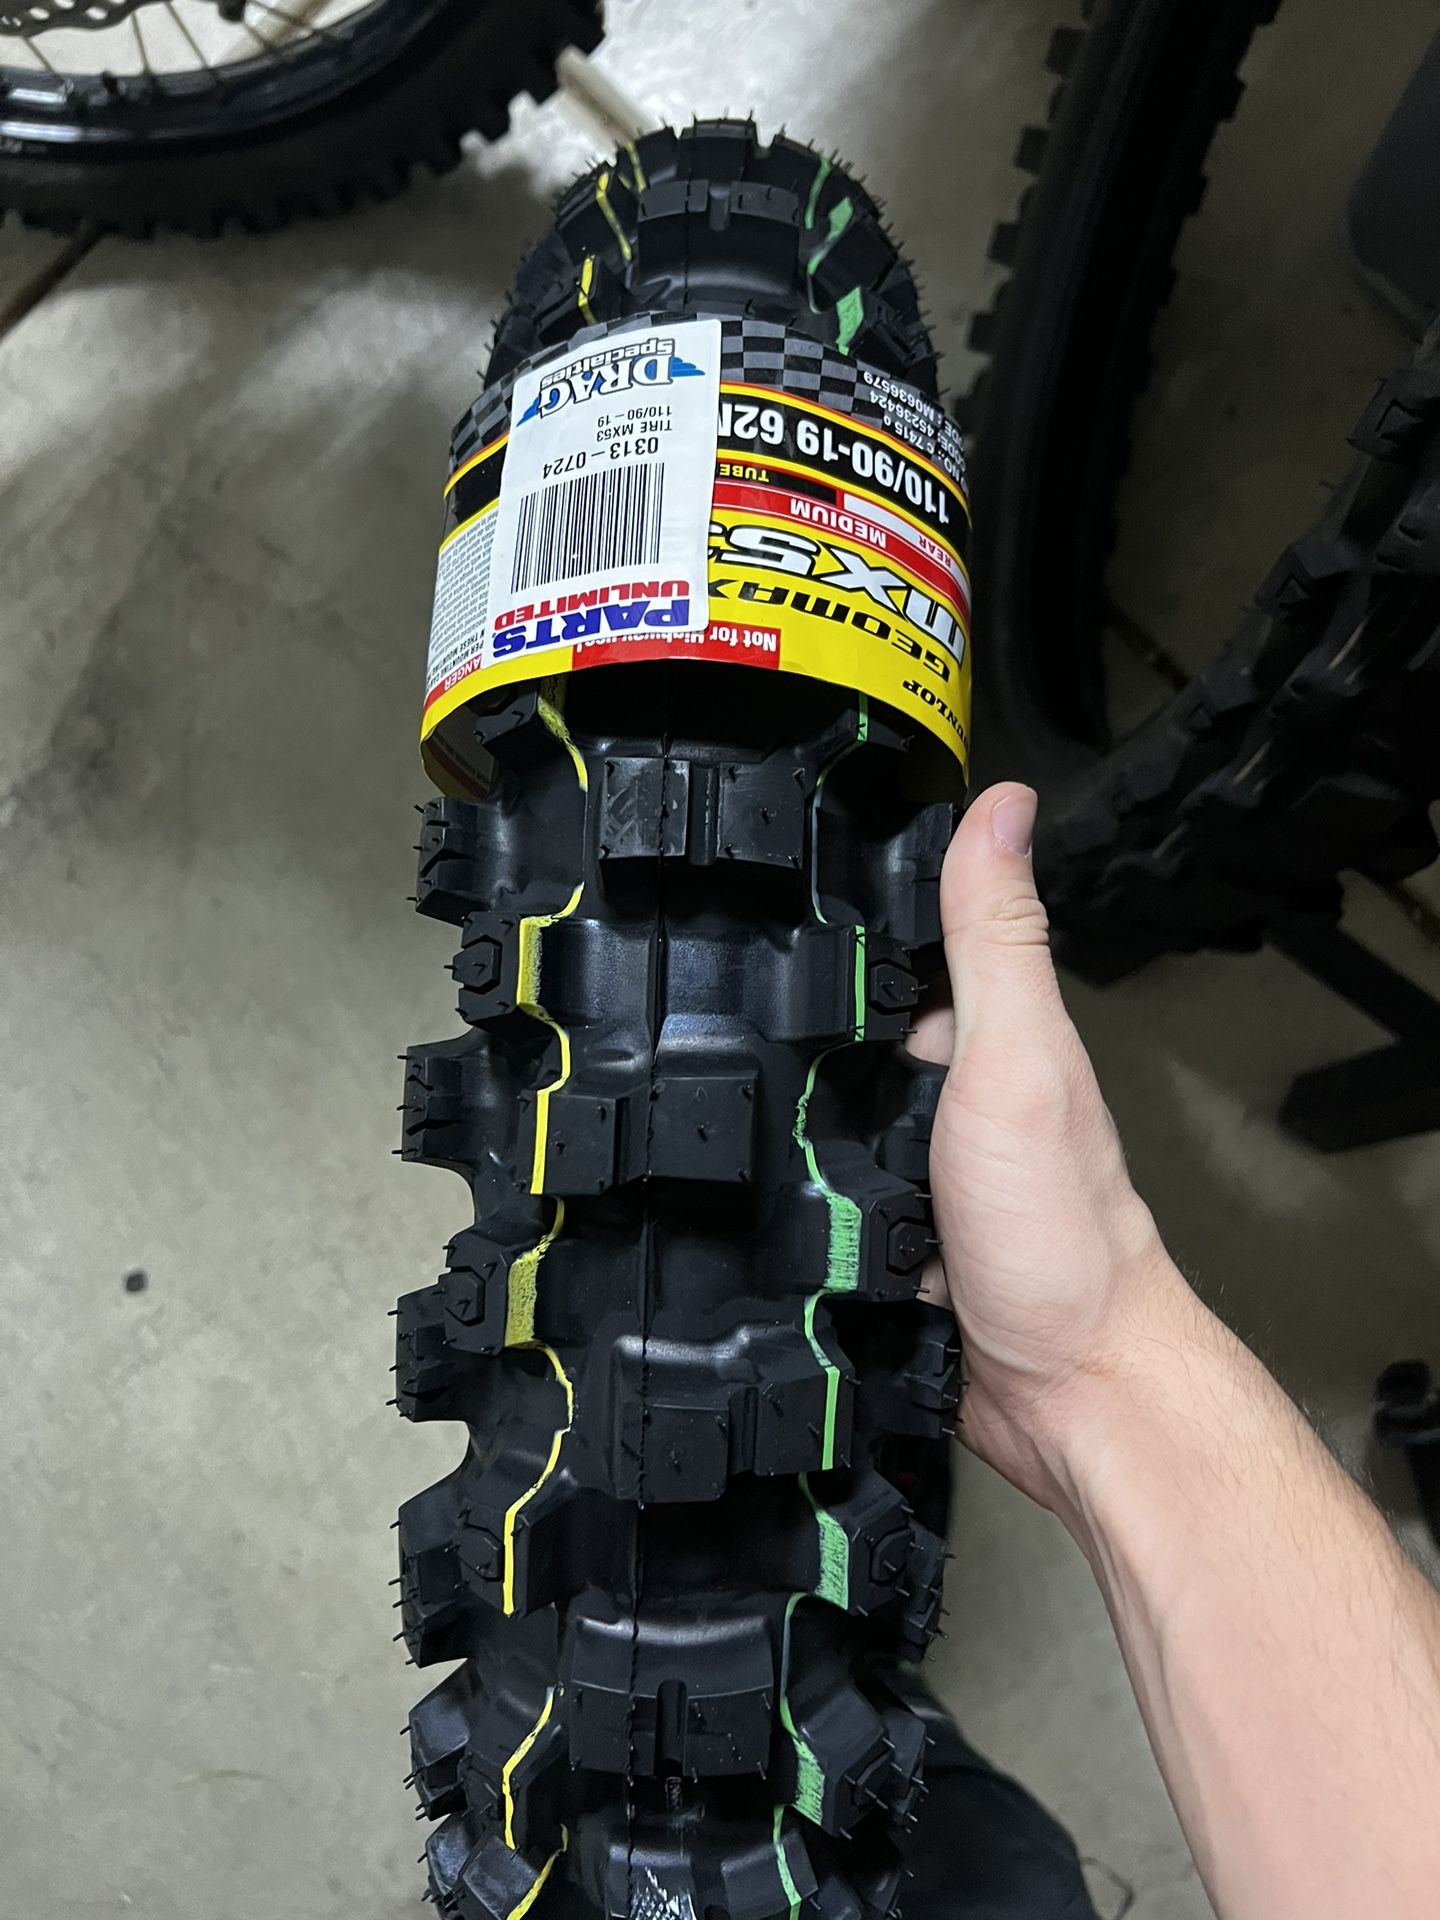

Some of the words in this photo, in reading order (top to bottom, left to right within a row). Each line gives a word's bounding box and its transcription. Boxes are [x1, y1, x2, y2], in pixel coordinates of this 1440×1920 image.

[540, 337, 675, 389] Specialties
[537, 356, 674, 419] DRAG
[864, 371, 934, 421] M0636579
[596, 423, 633, 442] MX53
[640, 420, 672, 433] TIRE
[869, 390, 934, 437] 45236424
[895, 421, 923, 450] 7415
[720, 464, 769, 482] TUBE
[796, 420, 949, 523] 110/90-19
[790, 499, 886, 549] MEDIUM
[918, 535, 951, 568] REAR
[494, 580, 690, 631] UNLIMITED
[493, 600, 689, 658] PARTS
[709, 626, 738, 646] for
[743, 630, 776, 652] Not
[444, 656, 480, 690] ANGER
